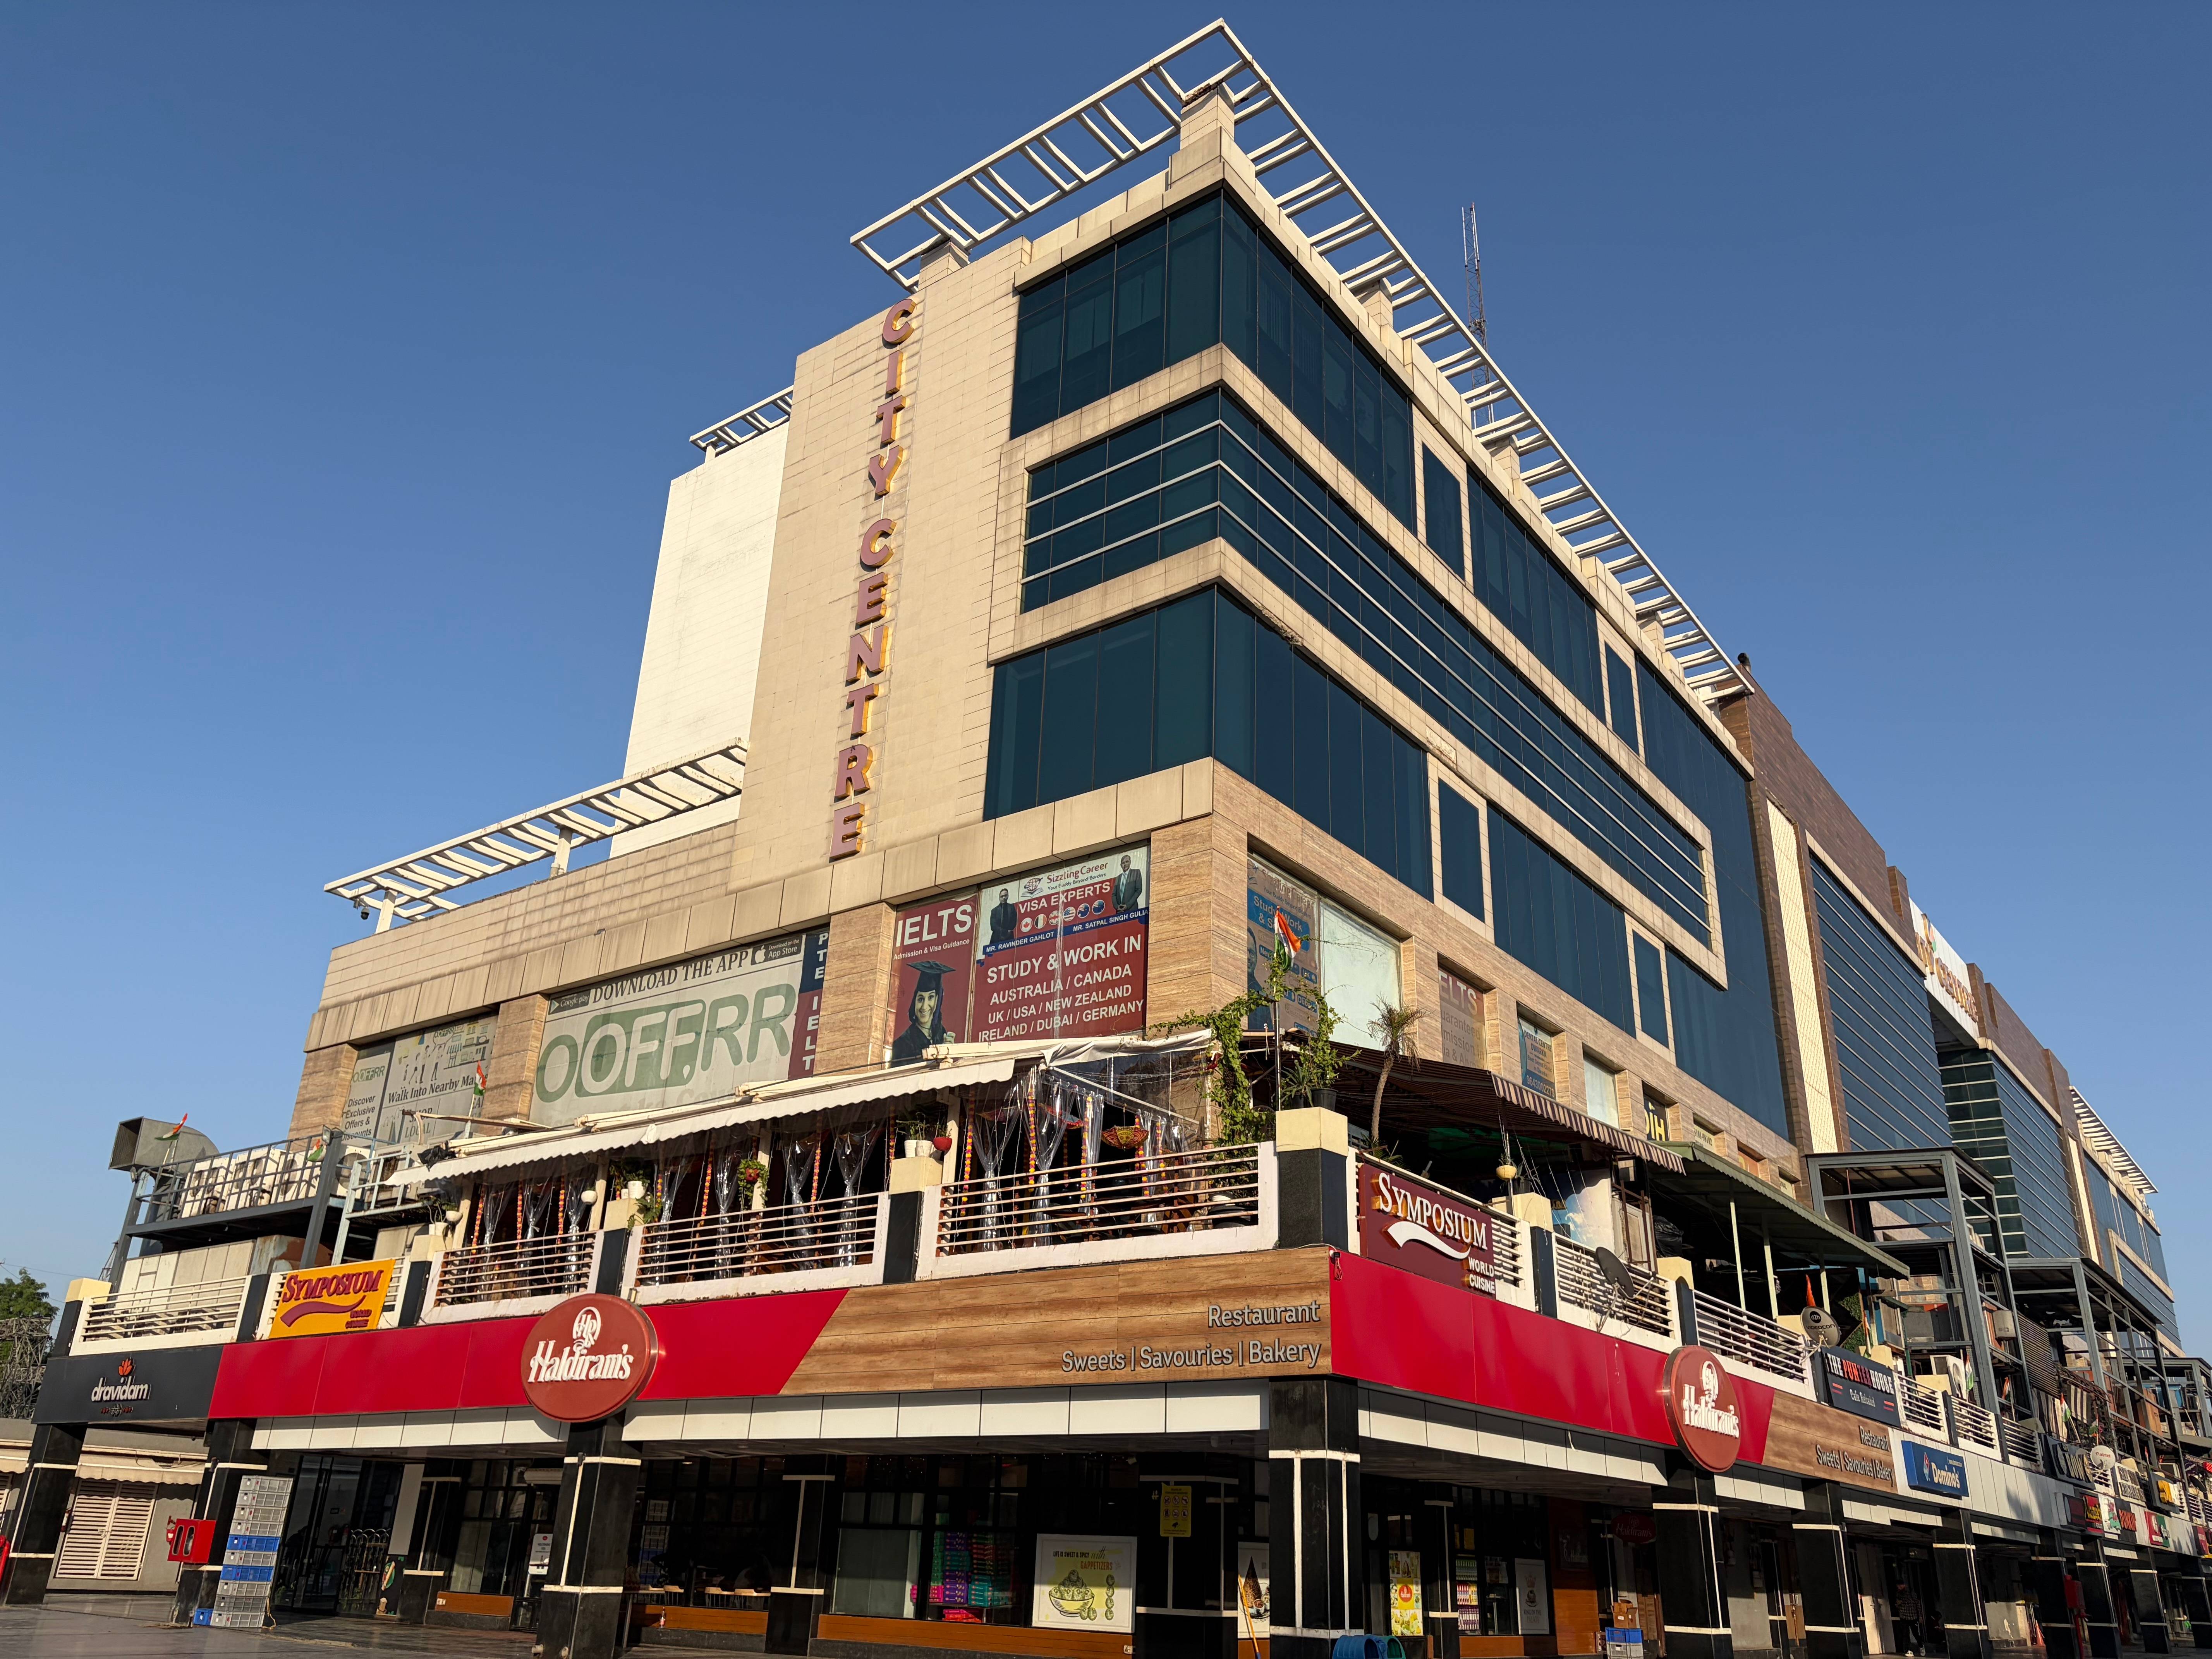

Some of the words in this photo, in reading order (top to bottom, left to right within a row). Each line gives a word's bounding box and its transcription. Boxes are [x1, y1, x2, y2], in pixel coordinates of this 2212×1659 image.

[868, 298, 917, 496] CITY
[830, 518, 897, 862] CENTRE
[1047, 869, 1081, 886] Sizzling
[1080, 862, 1108, 876] Career
[1072, 876, 1088, 886] Beyond
[1089, 872, 1106, 881] Borders
[1019, 898, 1047, 914] VISA
[1051, 882, 1111, 906] EXPERTS
[896, 904, 972, 947] IELTS
[986, 944, 997, 953] MR.
[998, 938, 1028, 951] RAVINDER
[1029, 931, 1054, 944] GAHLOT
[1073, 924, 1084, 932] MR.
[1085, 918, 1108, 930] SATPAL
[1109, 914, 1128, 925] SINGH
[1129, 909, 1149, 919] GULIA
[768, 941, 787, 950] Download
[768, 950, 781, 959] App
[782, 946, 798, 955] Store
[893, 947, 922, 960] Admission
[929, 943, 941, 953] Visa
[943, 938, 970, 950] Guidance
[987, 956, 1042, 984] STUDY
[1047, 953, 1058, 970] &
[1063, 939, 1119, 967] WORK
[1124, 934, 1141, 953] IN
[592, 967, 677, 1004] DOWNLOAD
[683, 961, 713, 981] THE
[716, 949, 749, 975] APP
[990, 978, 1063, 1005] AUSTRALIA
[1073, 963, 1132, 987] CANADA
[560, 996, 578, 1008] Google
[579, 994, 589, 1004] play
[988, 1010, 1004, 1024] UK
[1013, 1001, 1036, 1018] USA
[1046, 994, 1072, 1013] NEW
[1075, 984, 1132, 1006] ZEALAND
[978, 1021, 1027, 1042] IRELAND
[1037, 1013, 1073, 1032] DUBAI
[1082, 999, 1144, 1022] GERMANY
[1524, 1029, 1539, 1045] DENTAL
[1538, 1037, 1552, 1052] CENTRE
[1531, 1043, 1547, 1058] DWARKA
[348, 1095, 376, 1108] Discover
[388, 1087, 409, 1104] Walk
[410, 1087, 427, 1099] Into
[428, 1079, 460, 1095] Nearby
[345, 1106, 375, 1119] Exclusive
[345, 1120, 364, 1130] Offers
[365, 1116, 370, 1125] &
[1378, 1172, 1488, 1251] SYMPOSIUM
[1468, 1256, 1495, 1278] WORLD
[282, 1269, 384, 1303] SYMPOSIUM
[1469, 1274, 1496, 1295] CUISINE
[1208, 1300, 1321, 1329] Restaurant
[527, 1339, 634, 1383] Haldiram's
[1061, 1349, 1126, 1372] Sweets
[1139, 1343, 1233, 1369] Savouries
[1249, 1338, 1321, 1369] Bakery
[1826, 1353, 1844, 1377] THE
[1841, 1359, 1872, 1386] PUNTER
[1869, 1369, 1894, 1395] HOUSE
[91, 1376, 151, 1402] dravidam
[1682, 1383, 1740, 1439] Haldiram's
[1859, 1425, 1889, 1452] Restaurant
[1816, 1443, 1839, 1470] Sweets
[1844, 1450, 1873, 1478] Savouries
[1875, 1459, 1894, 1487] Bakery
[1931, 1462, 1961, 1489] Domino's
[1080, 1561, 1113, 1571] GAPPETIZERS
